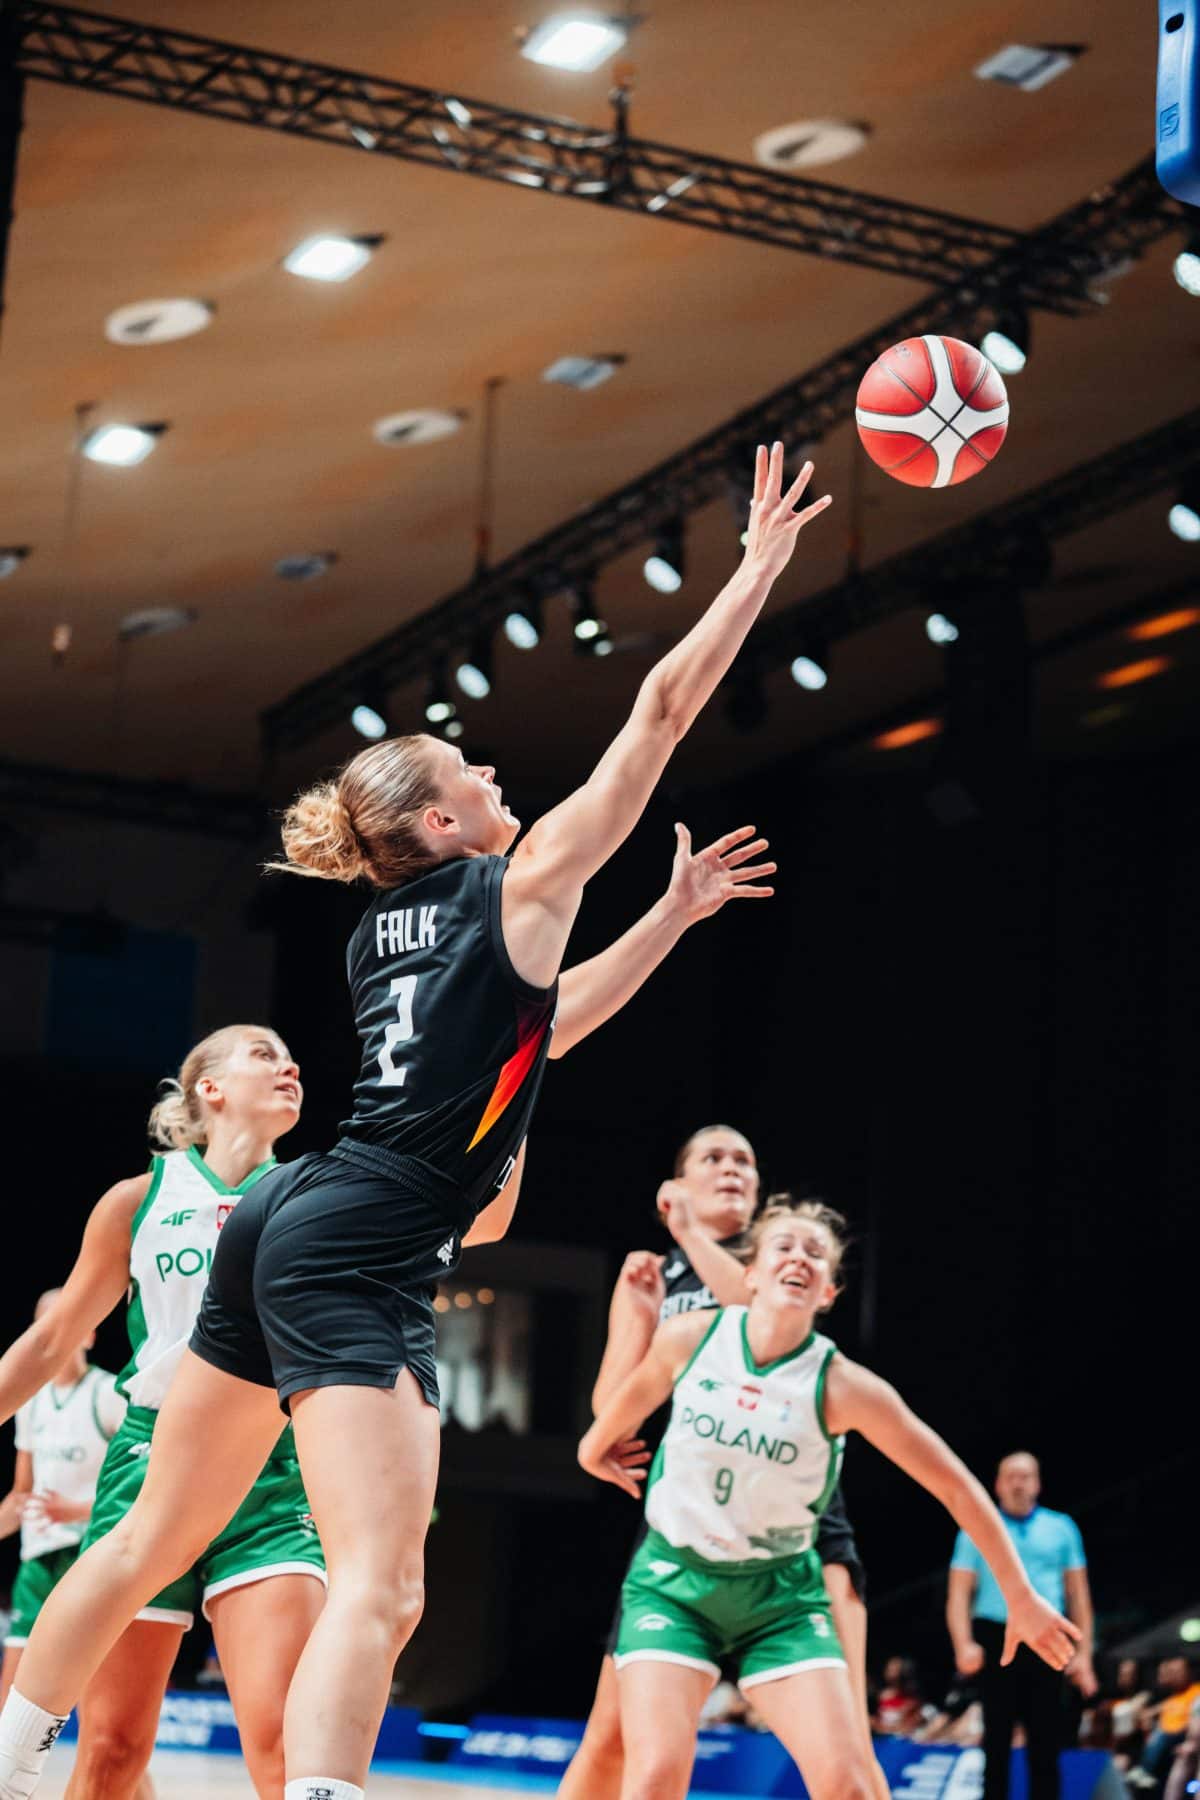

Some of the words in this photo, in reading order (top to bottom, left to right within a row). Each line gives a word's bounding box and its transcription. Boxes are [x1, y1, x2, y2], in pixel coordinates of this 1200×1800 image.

[376, 905, 438, 958] FALK
[377, 975, 417, 1086] 2
[161, 1209, 196, 1226] 4F
[680, 1407, 799, 1465] POLAND
[714, 1467, 734, 1505] 9
